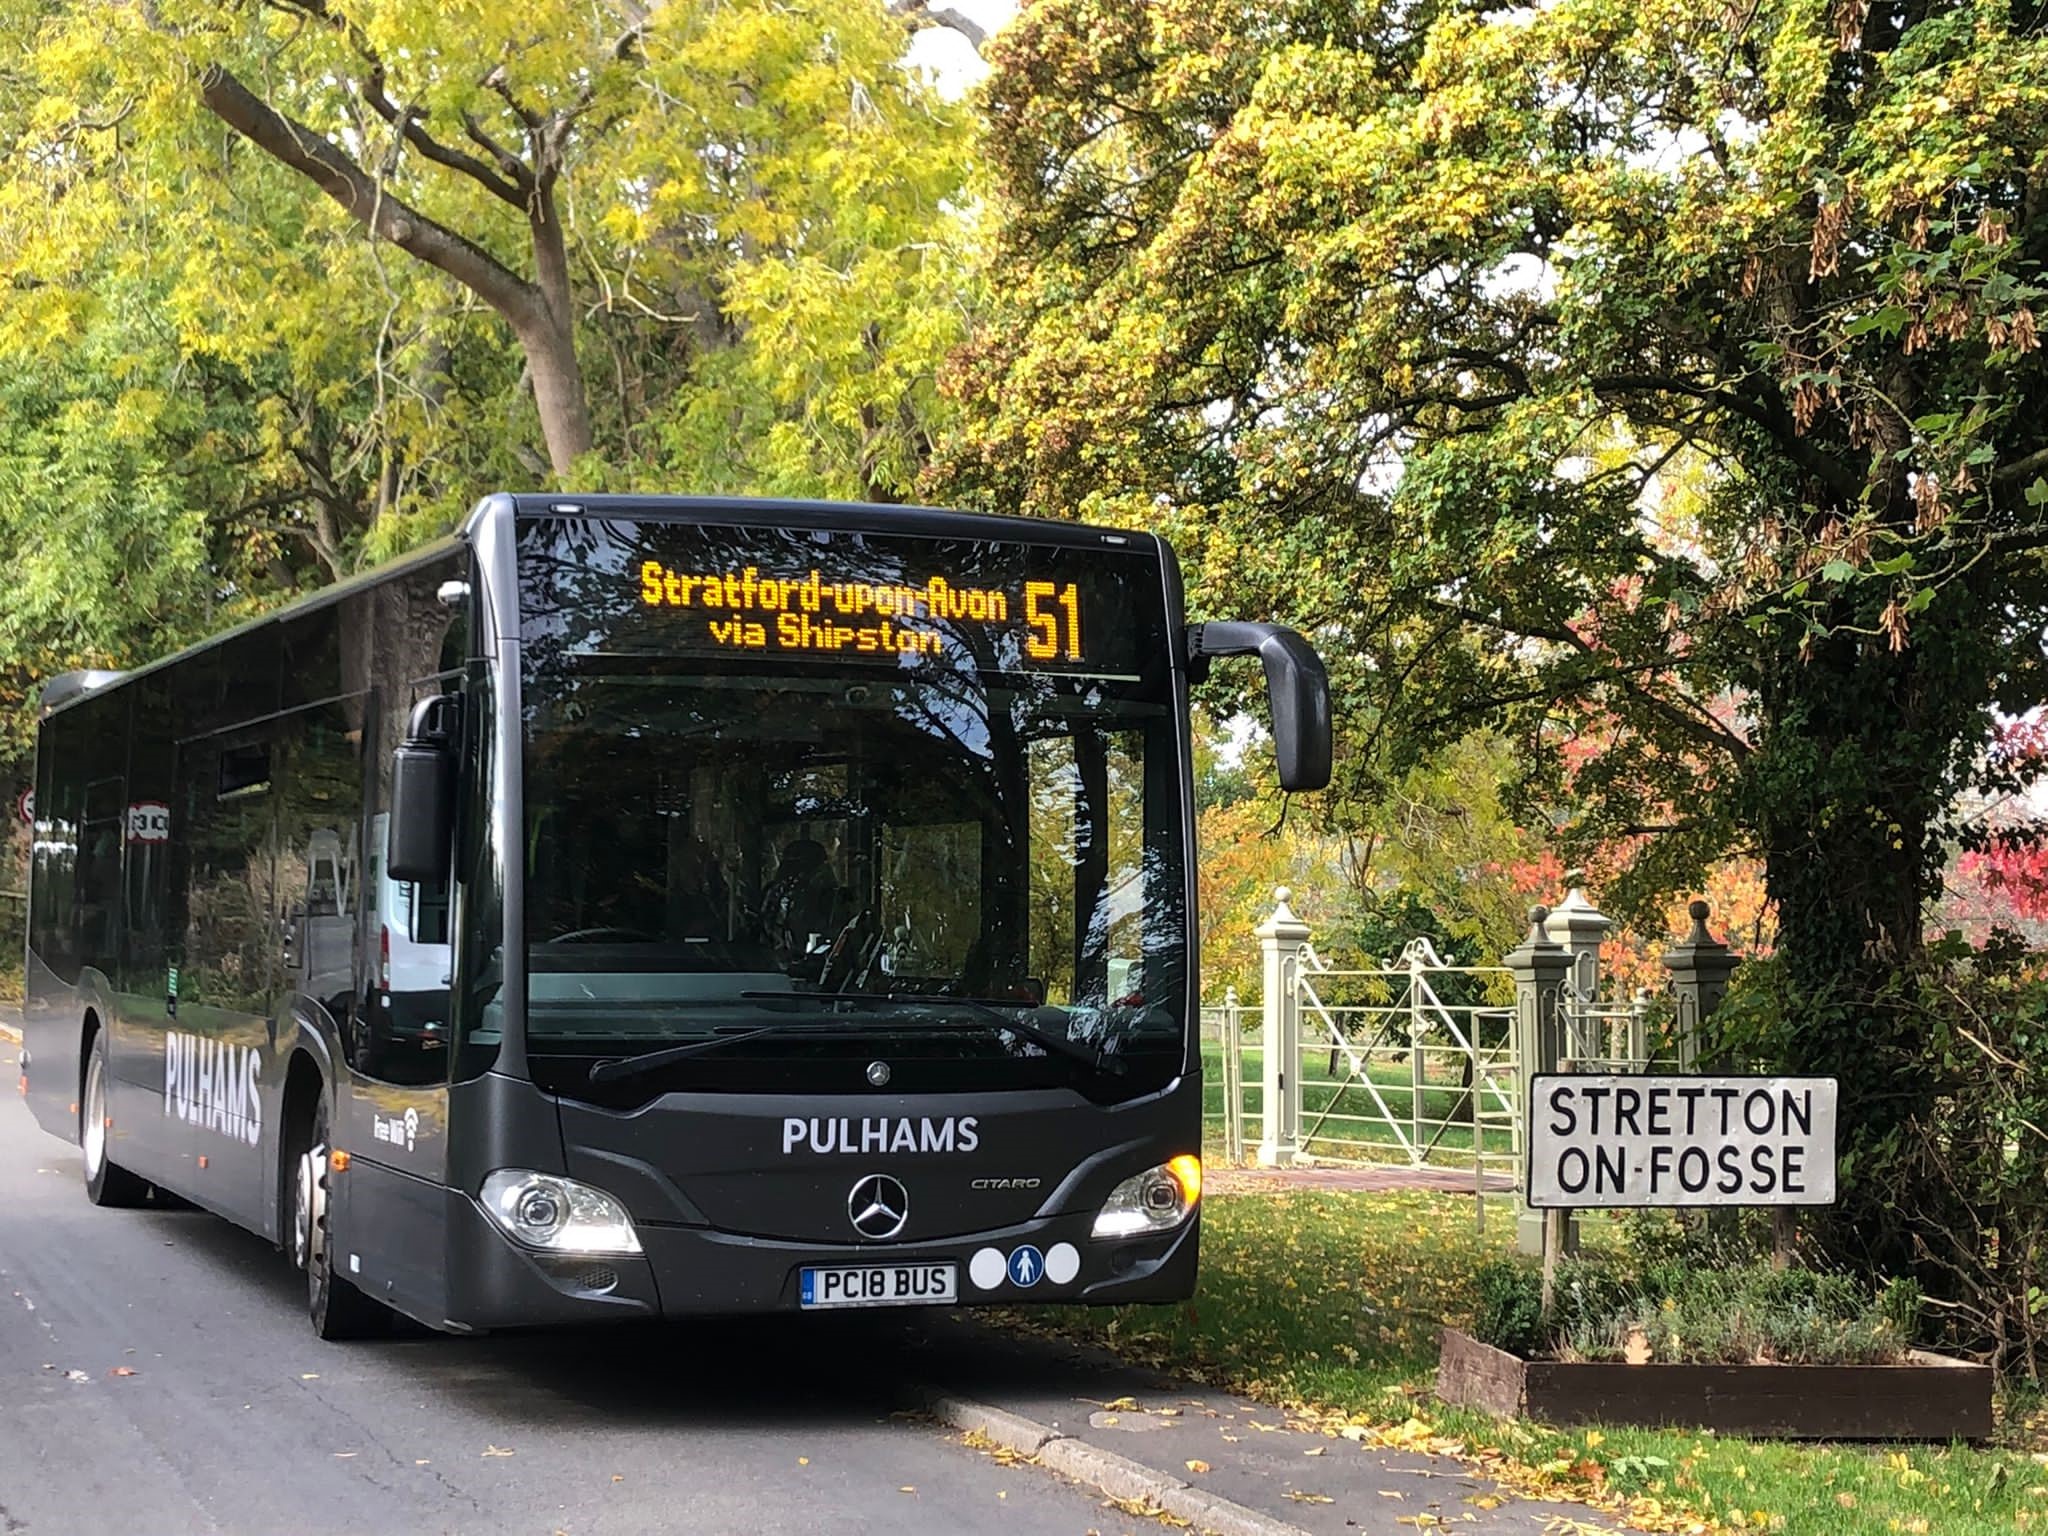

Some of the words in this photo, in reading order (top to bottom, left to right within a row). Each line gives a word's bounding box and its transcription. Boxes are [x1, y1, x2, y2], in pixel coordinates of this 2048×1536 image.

[641, 561, 1006, 620] Stratford-upon-Avon
[709, 613, 767, 647] via
[778, 612, 941, 653] Shipston
[1025, 581, 1081, 659] 51
[165, 1031, 261, 1146] PULHAMS
[1549, 1087, 1812, 1136] STRETTON
[782, 1117, 979, 1153] PULHAMS
[971, 1177, 1041, 1190] CITARO
[1557, 1144, 1805, 1194] ON-FOSSE
[824, 1270, 886, 1299] PC18
[894, 1268, 946, 1296] BUS
